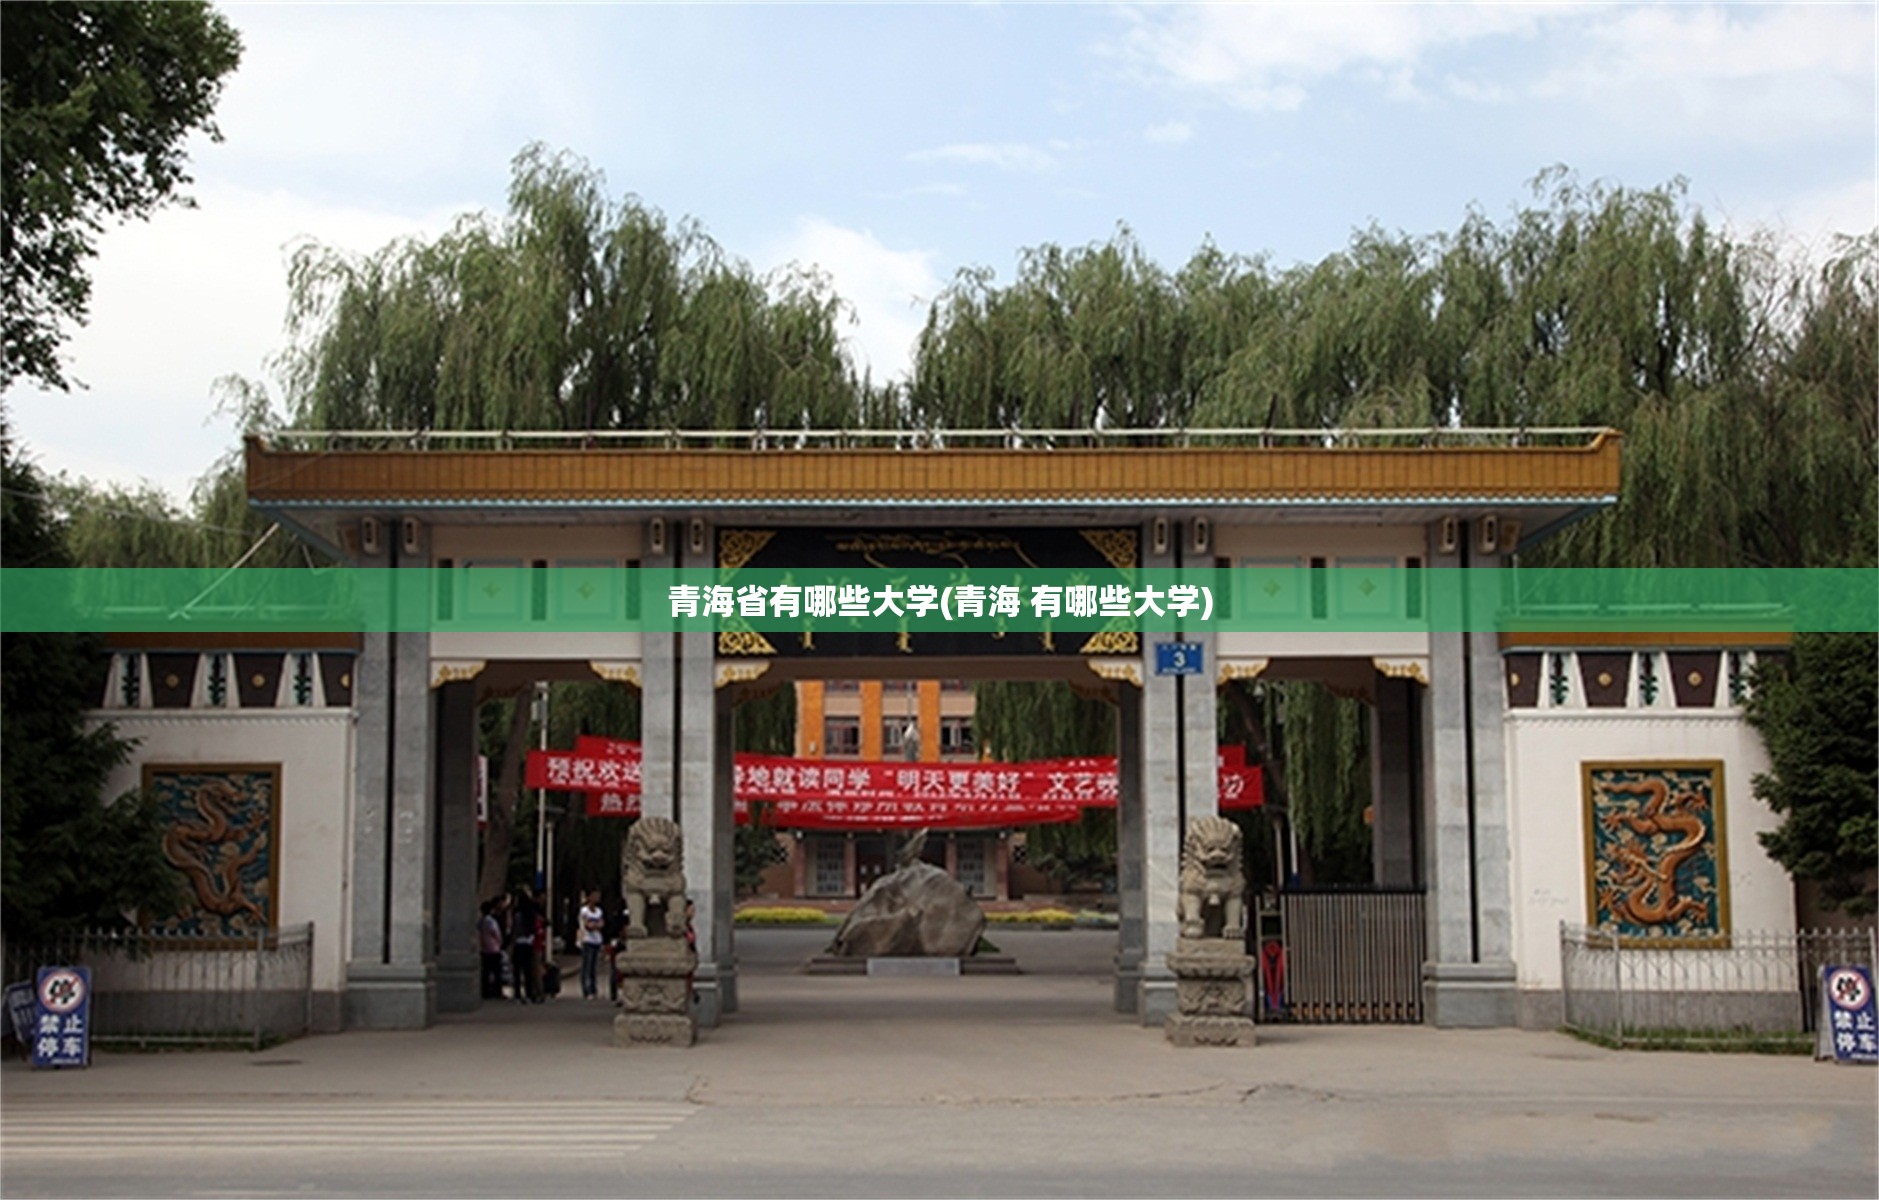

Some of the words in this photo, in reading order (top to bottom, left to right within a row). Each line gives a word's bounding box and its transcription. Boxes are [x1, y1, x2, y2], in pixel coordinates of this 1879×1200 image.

[1173, 651, 1186, 668] 3
[40, 1014, 82, 1034] 禁止
[1834, 1011, 1875, 1030] 禁止
[38, 1037, 82, 1057] 停车
[1837, 1032, 1878, 1053] 停车
